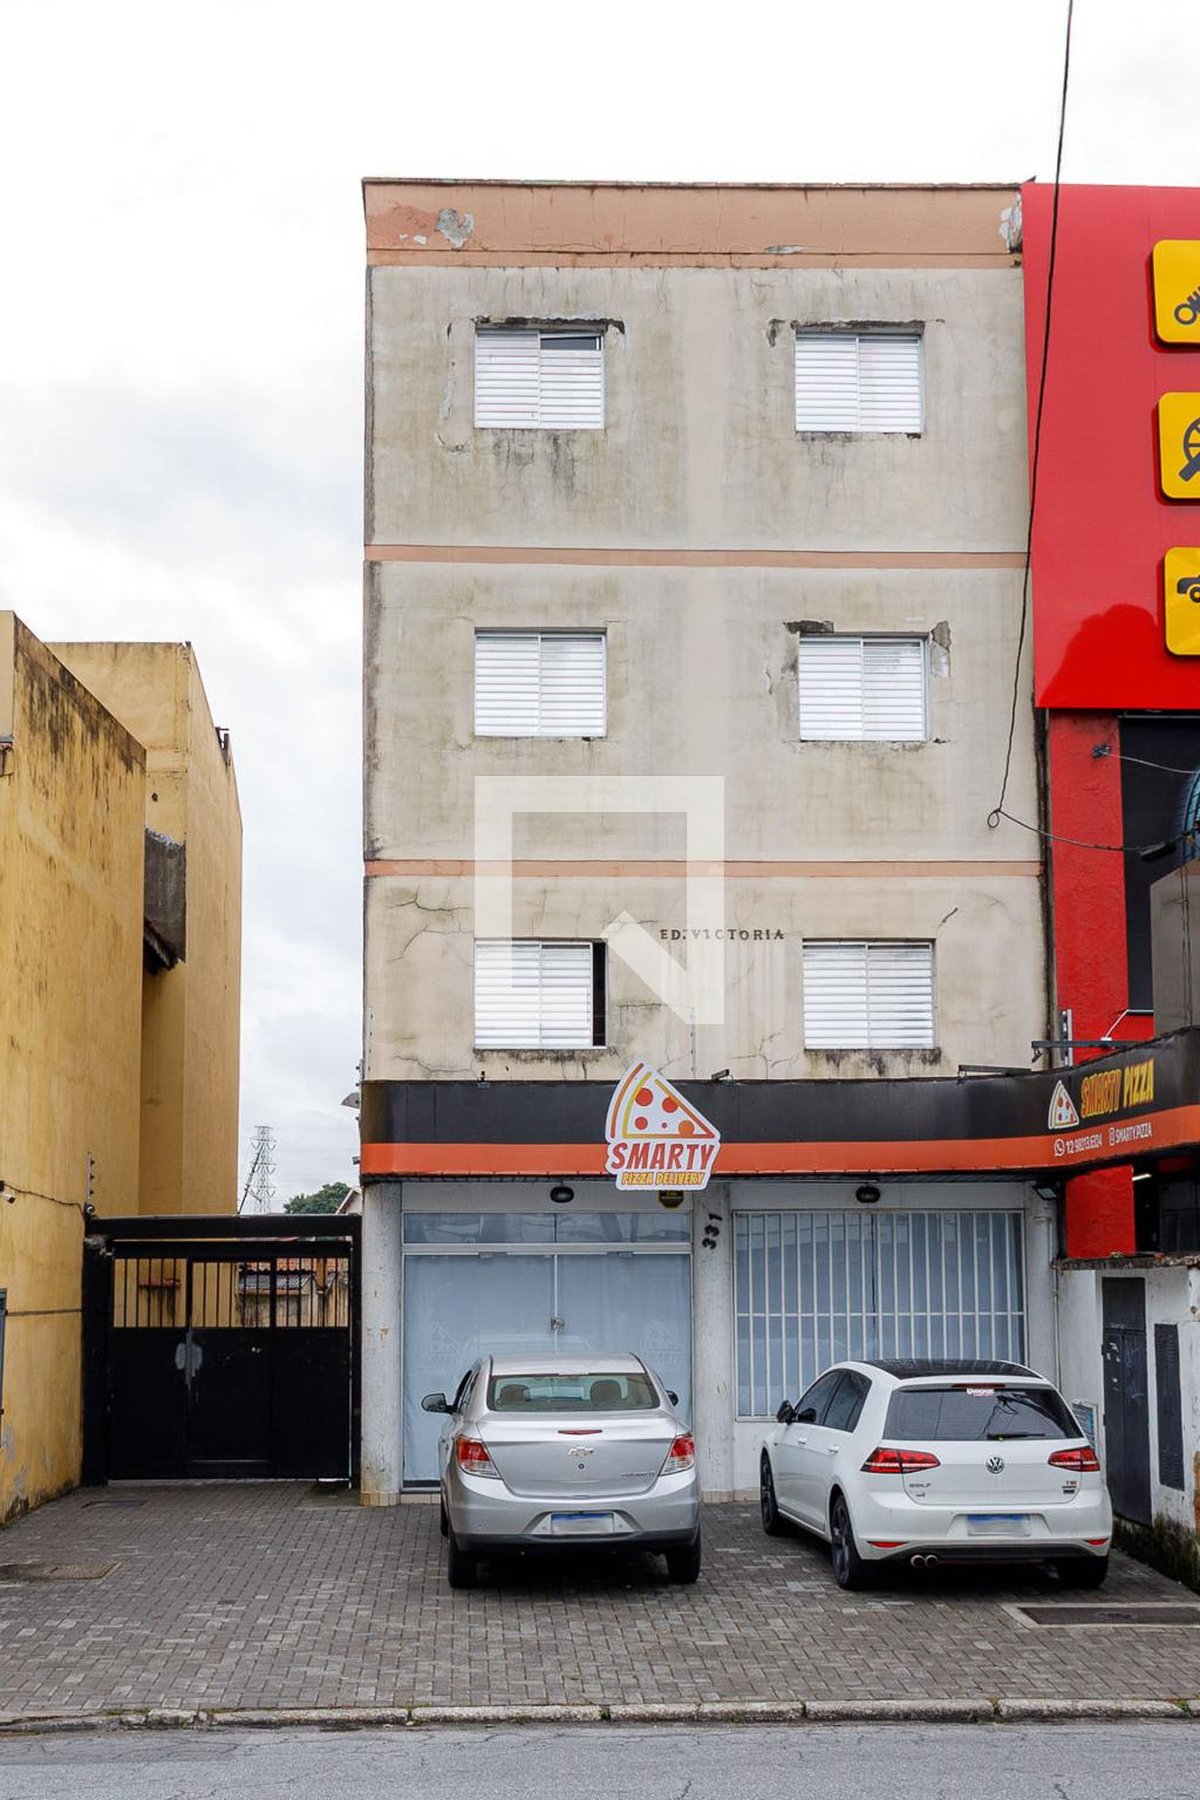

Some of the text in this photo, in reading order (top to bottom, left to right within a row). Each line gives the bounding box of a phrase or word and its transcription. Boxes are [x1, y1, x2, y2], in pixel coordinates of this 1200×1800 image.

[1081, 1058, 1154, 1119] SMARTY PIZZA
[611, 1142, 715, 1170] SMARTY
[621, 1172, 705, 1185] PIZZA DELIVERY
[702, 1213, 723, 1250] 331
